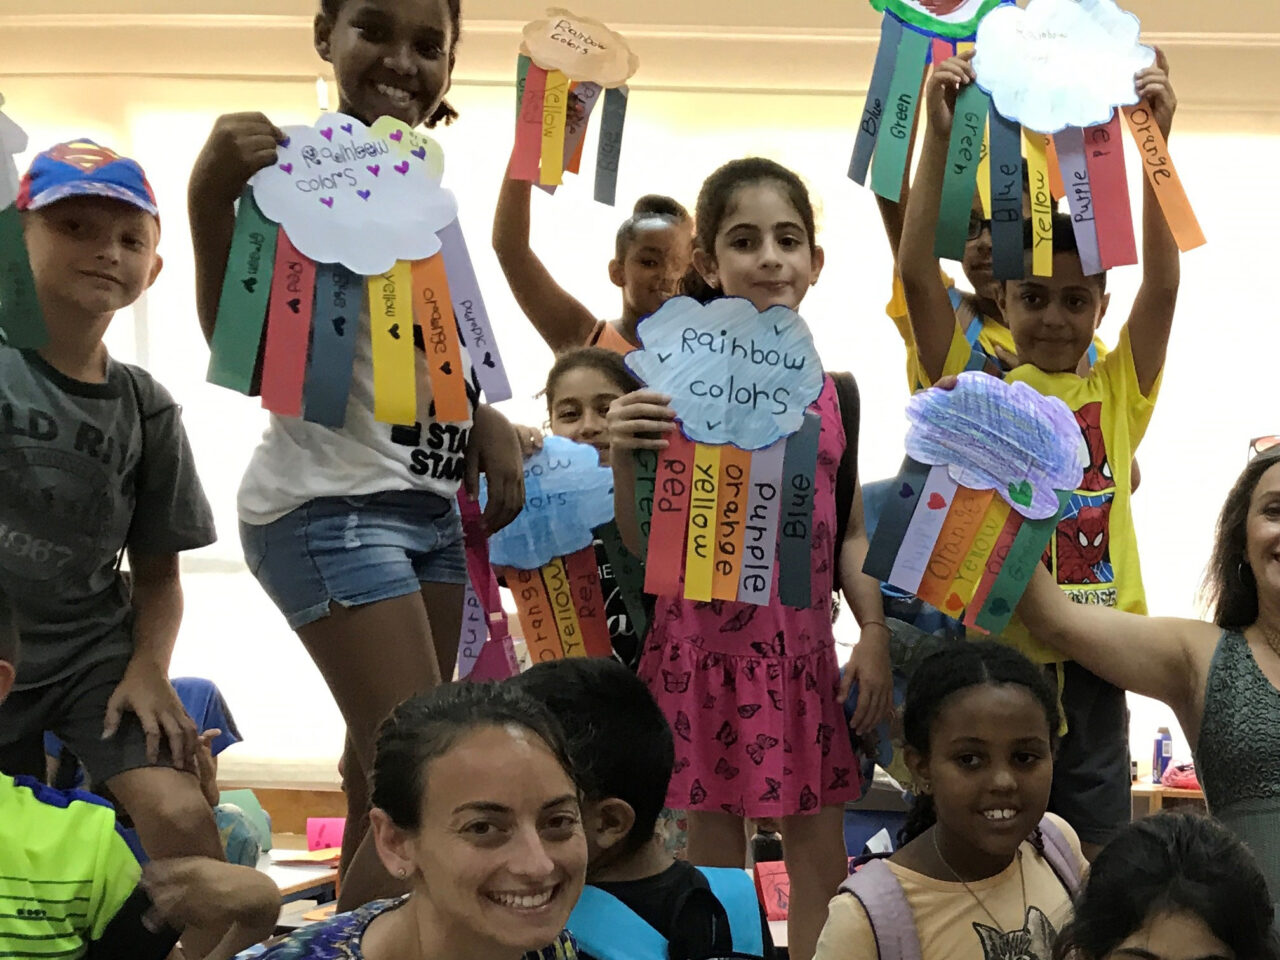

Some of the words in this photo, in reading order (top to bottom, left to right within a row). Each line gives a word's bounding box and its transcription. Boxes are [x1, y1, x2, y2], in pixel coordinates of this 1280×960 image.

[889, 92, 912, 140] Green
[658, 457, 687, 513] Red
[782, 473, 812, 540] Blue
